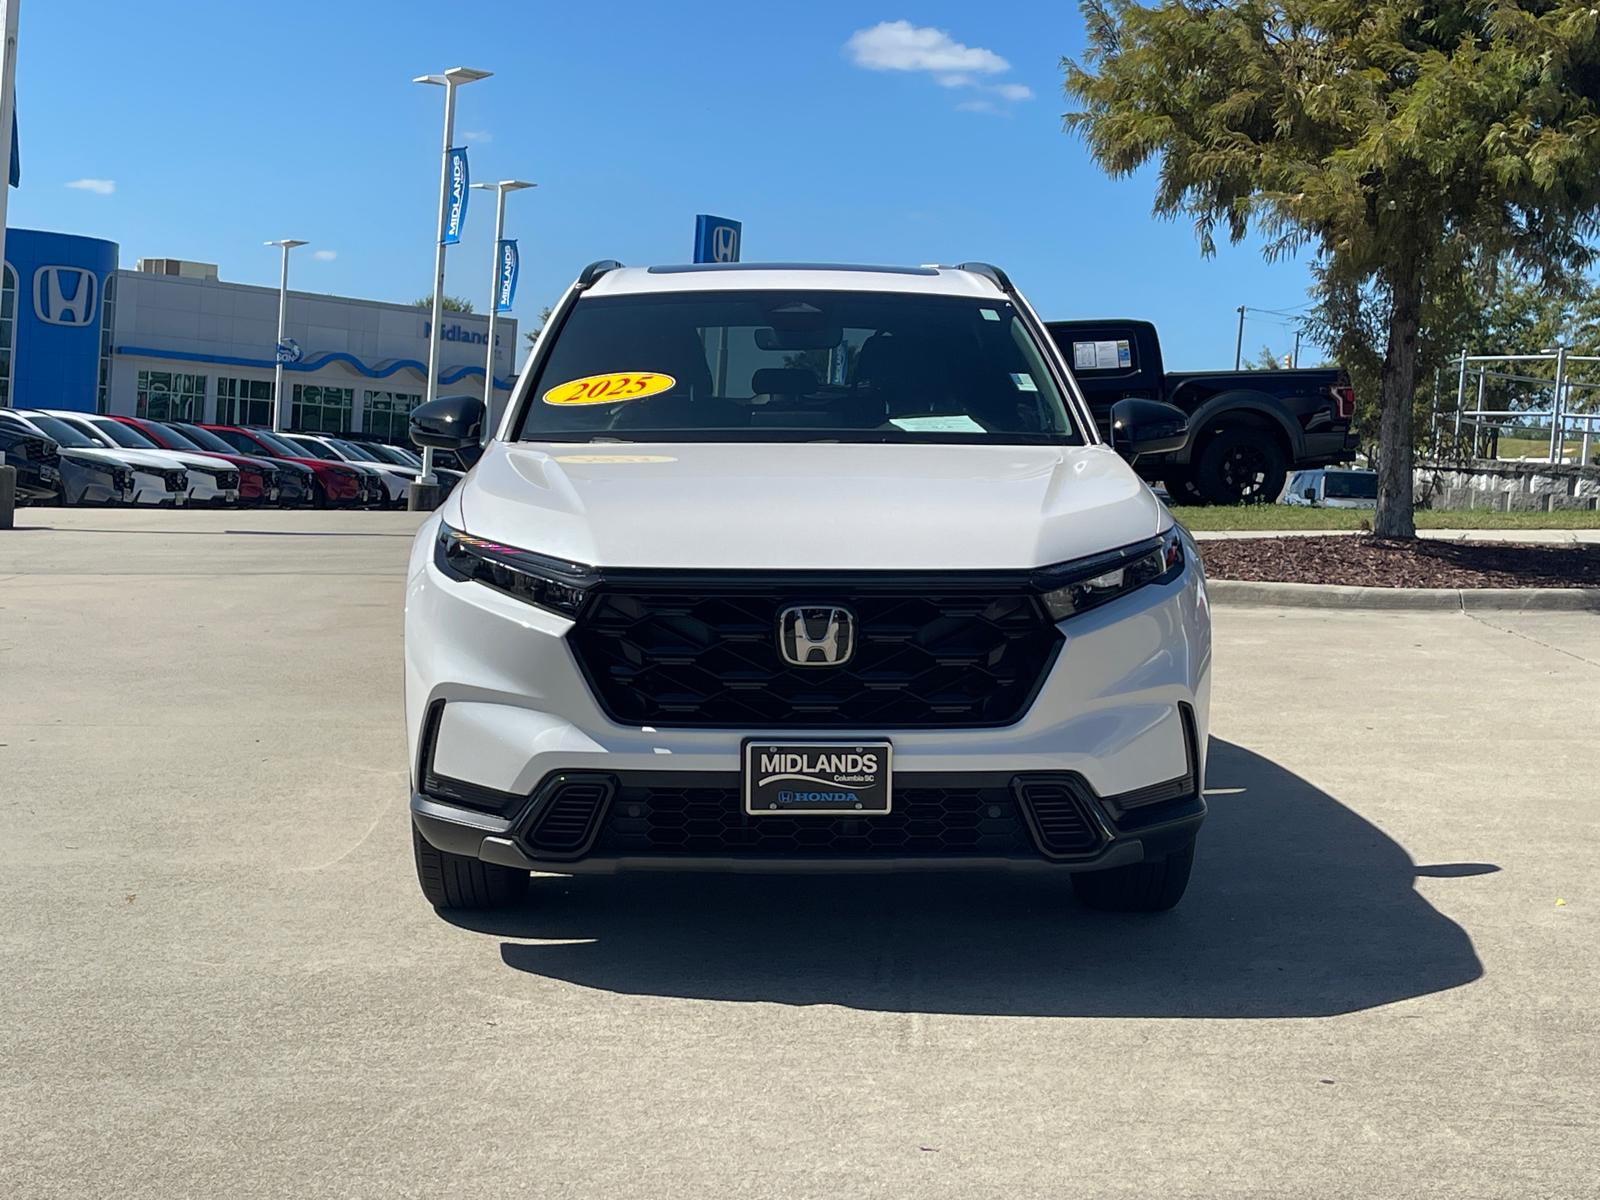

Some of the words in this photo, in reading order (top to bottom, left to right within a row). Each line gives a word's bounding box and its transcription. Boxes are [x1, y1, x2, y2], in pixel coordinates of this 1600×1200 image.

[449, 155, 461, 236] MIDLANDS
[501, 244, 512, 305] MIDLANDS
[563, 376, 654, 402] 2025
[760, 753, 878, 773] MIDLANDS
[833, 774, 864, 782] Columbia
[864, 774, 875, 782] SC
[794, 792, 859, 802] HONDA
